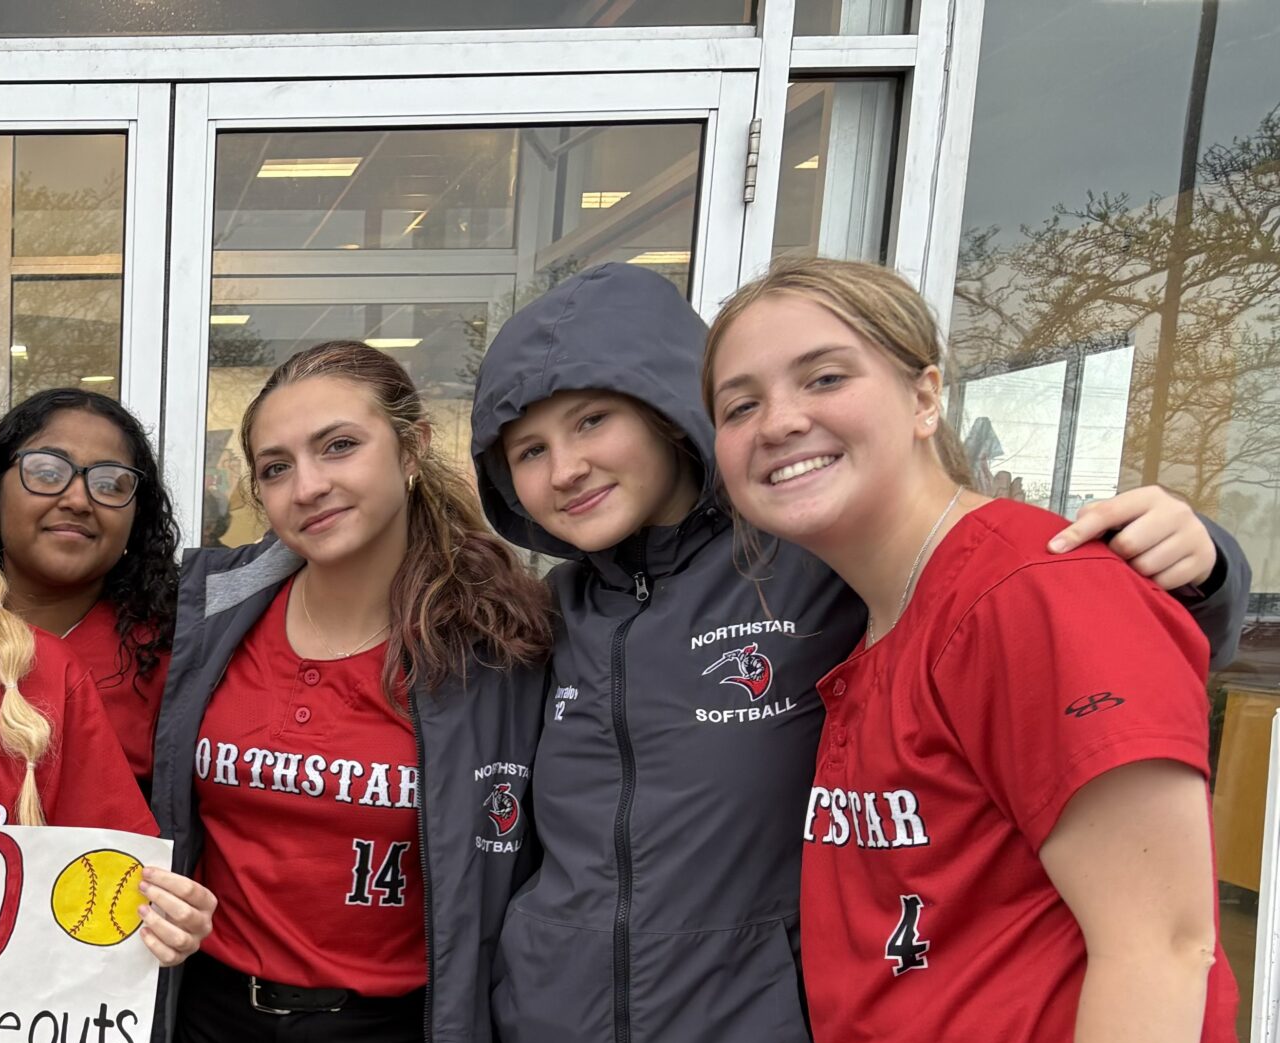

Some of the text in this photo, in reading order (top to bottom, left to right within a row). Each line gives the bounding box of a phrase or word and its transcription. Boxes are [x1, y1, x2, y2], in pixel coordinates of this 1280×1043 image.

[691, 620, 795, 649] NORTHSTAR
[554, 701, 566, 721] 12
[695, 697, 797, 723] SOFTBALL
[195, 737, 421, 809] ORTHSTAR
[345, 838, 411, 906] 14
[885, 894, 931, 976] 4
